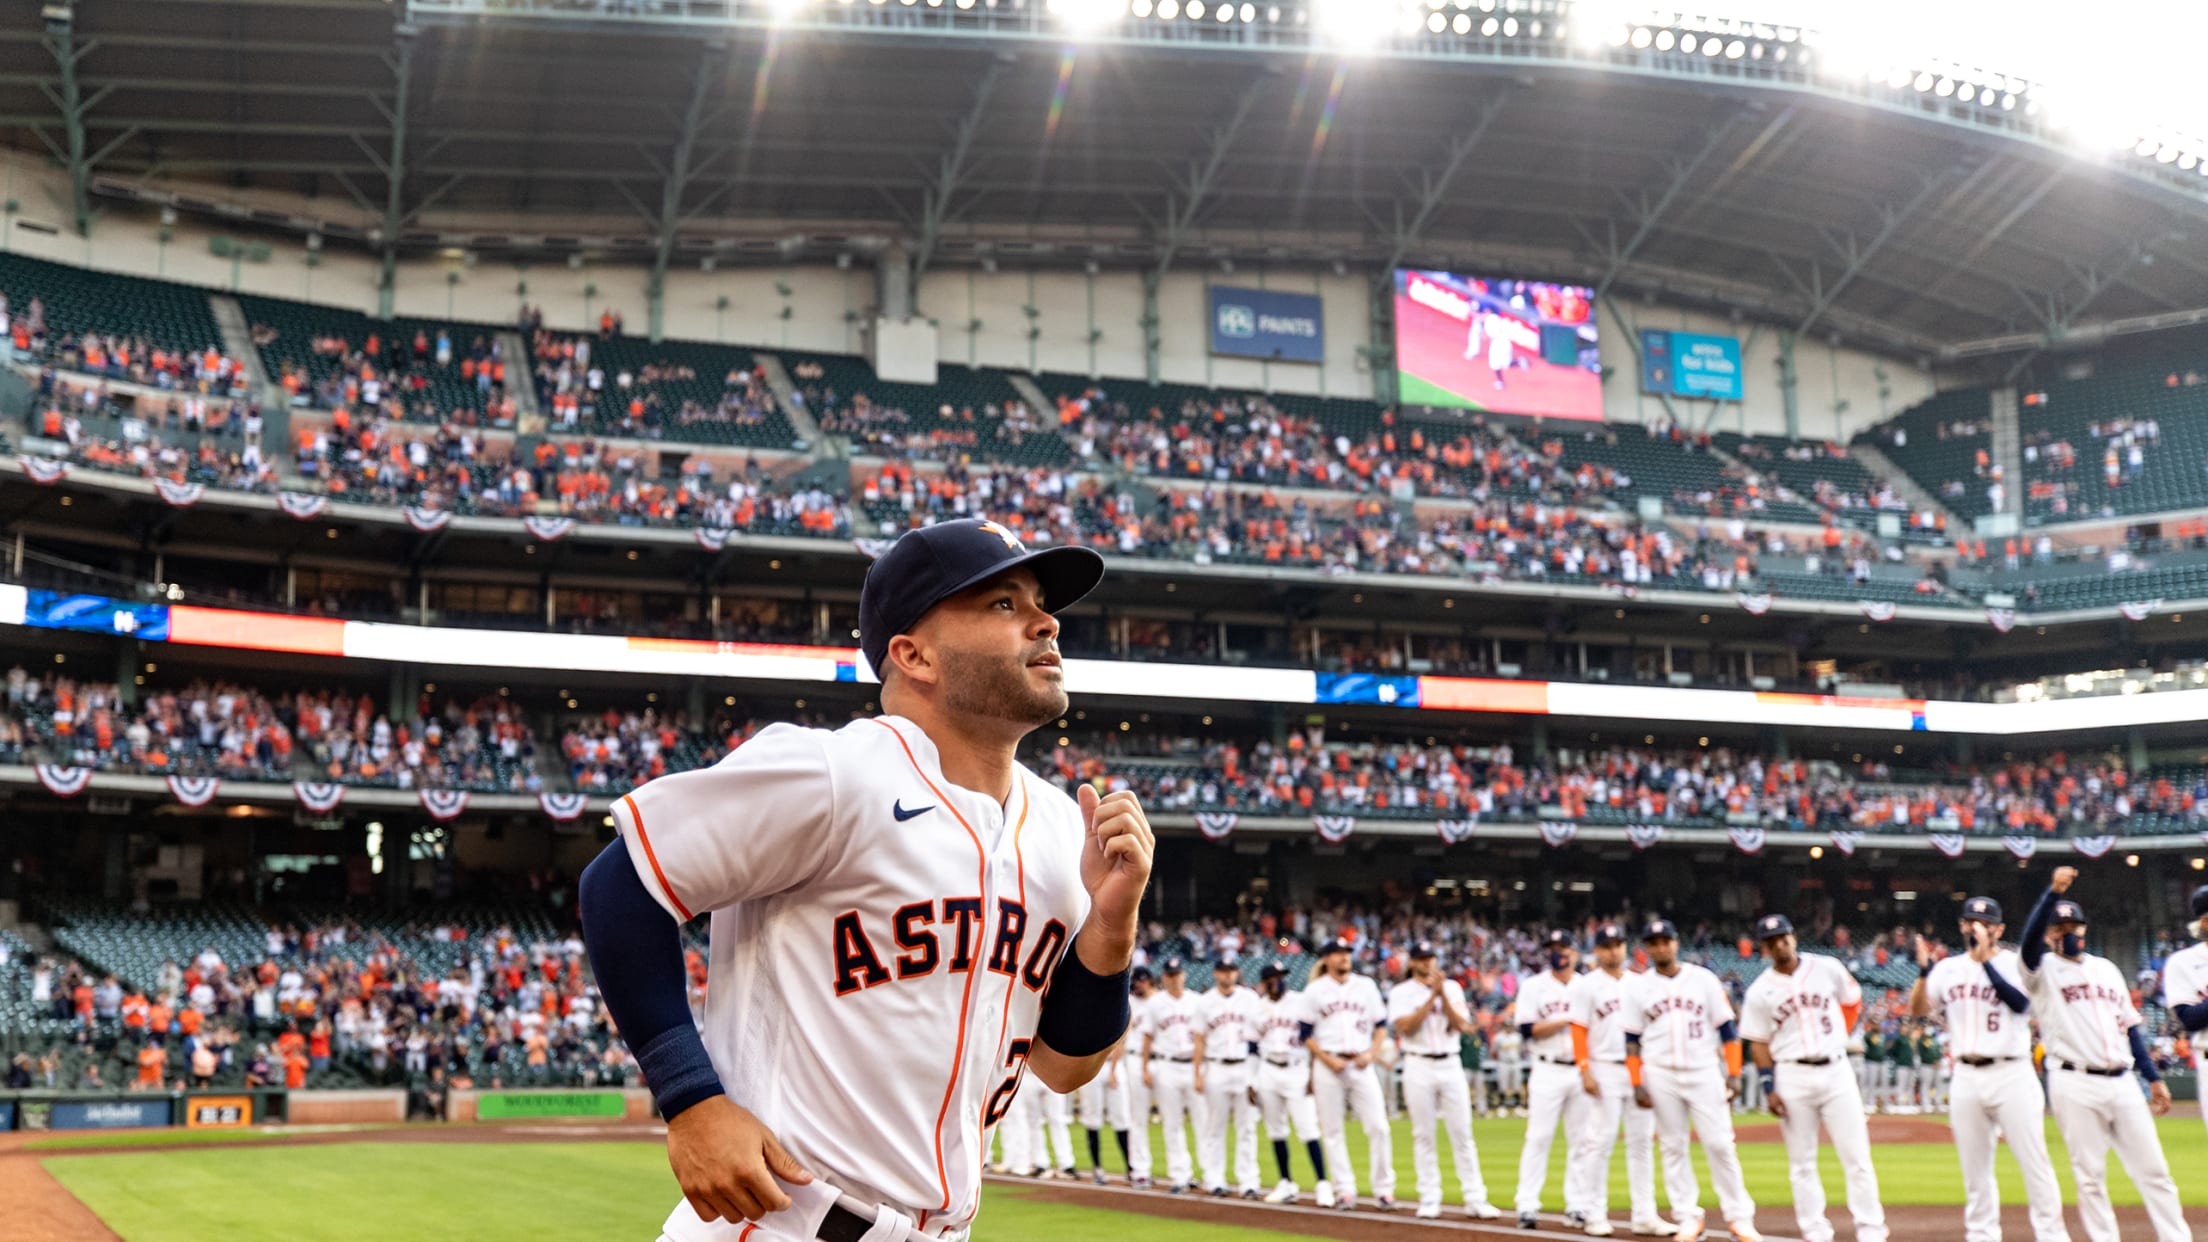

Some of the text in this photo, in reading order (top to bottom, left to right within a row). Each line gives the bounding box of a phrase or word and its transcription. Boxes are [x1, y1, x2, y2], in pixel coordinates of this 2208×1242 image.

[1259, 314, 1316, 337] PAINTS
[833, 896, 1066, 999] ASTRO
[1595, 998, 1620, 1019] AST
[1645, 997, 1703, 1022] ASTROS
[1773, 993, 1829, 1030] ASTROS
[1688, 1020, 1703, 1039] 15
[1987, 1011, 2000, 1031] 6
[984, 1038, 1031, 1129] 2
